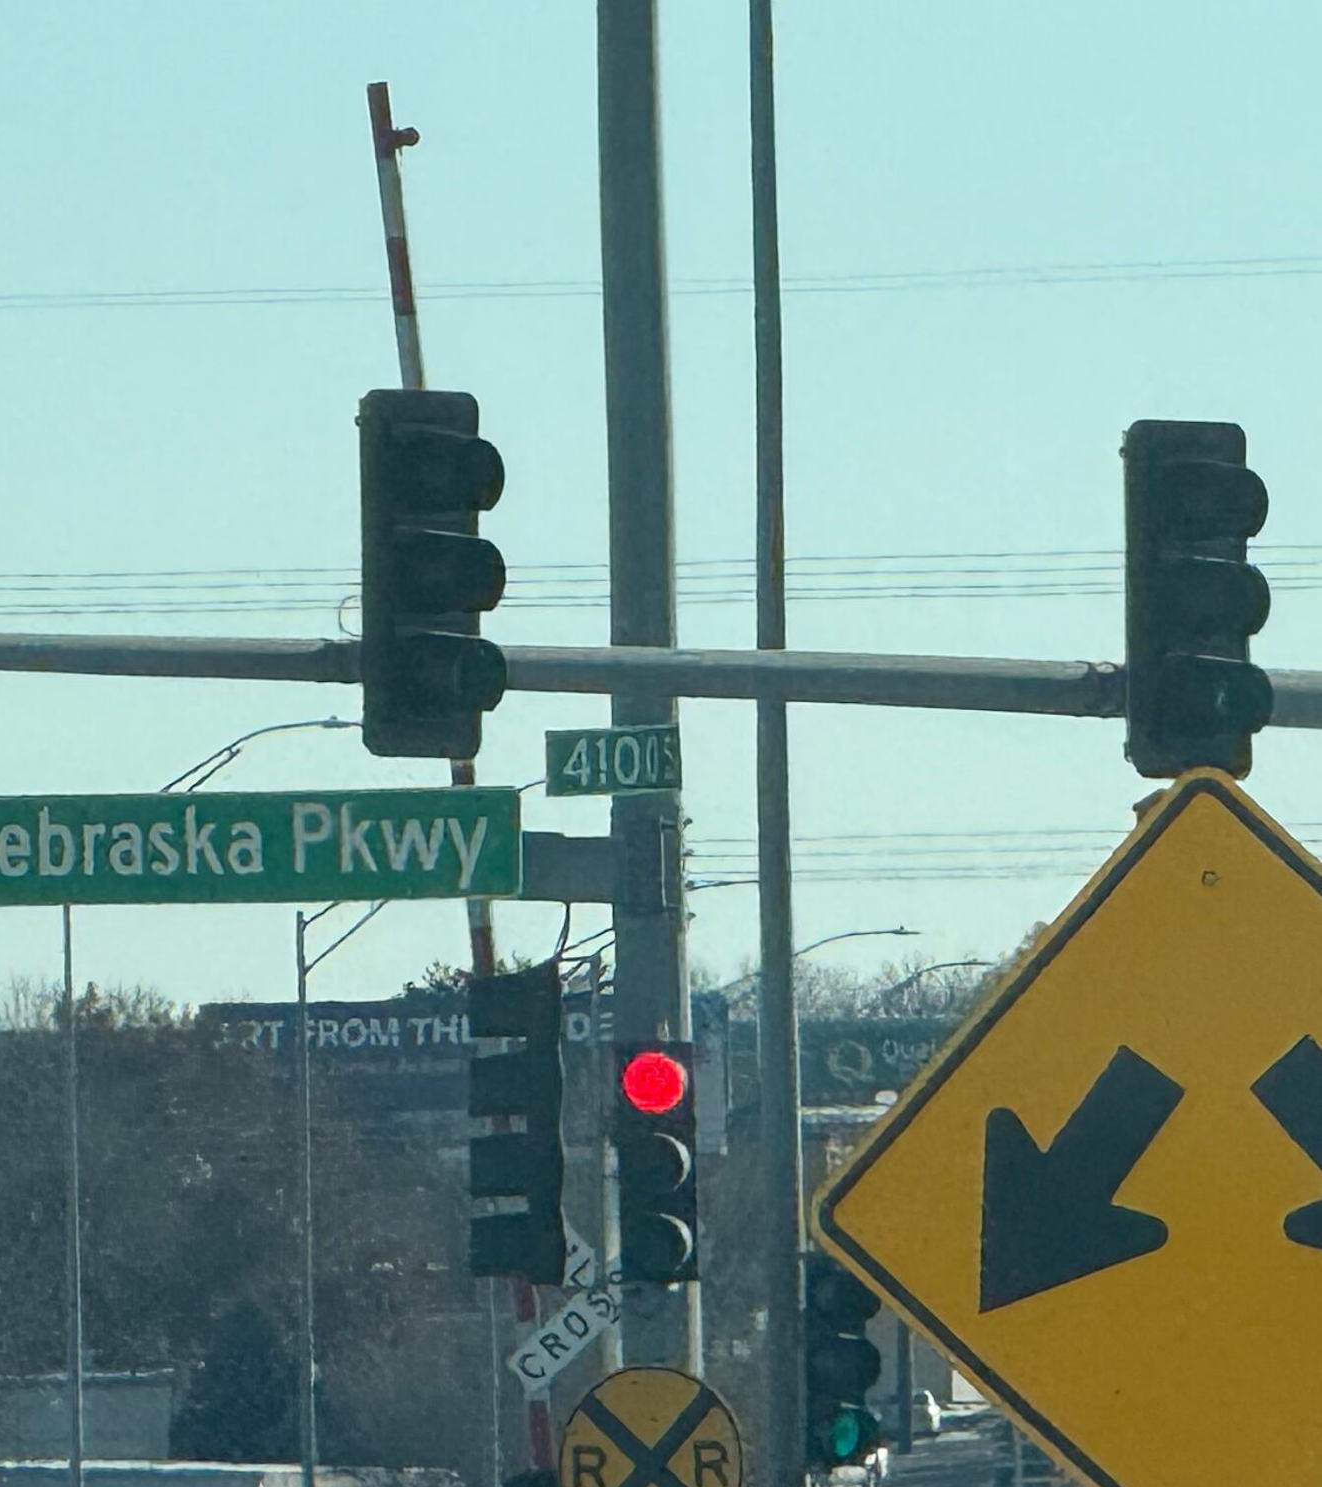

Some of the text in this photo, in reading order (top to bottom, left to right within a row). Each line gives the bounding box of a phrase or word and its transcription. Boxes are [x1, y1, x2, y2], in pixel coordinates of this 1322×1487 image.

[562, 735, 658, 787] 4100
[292, 800, 489, 890] Pkwy
[881, 1038, 937, 1065] Qual
